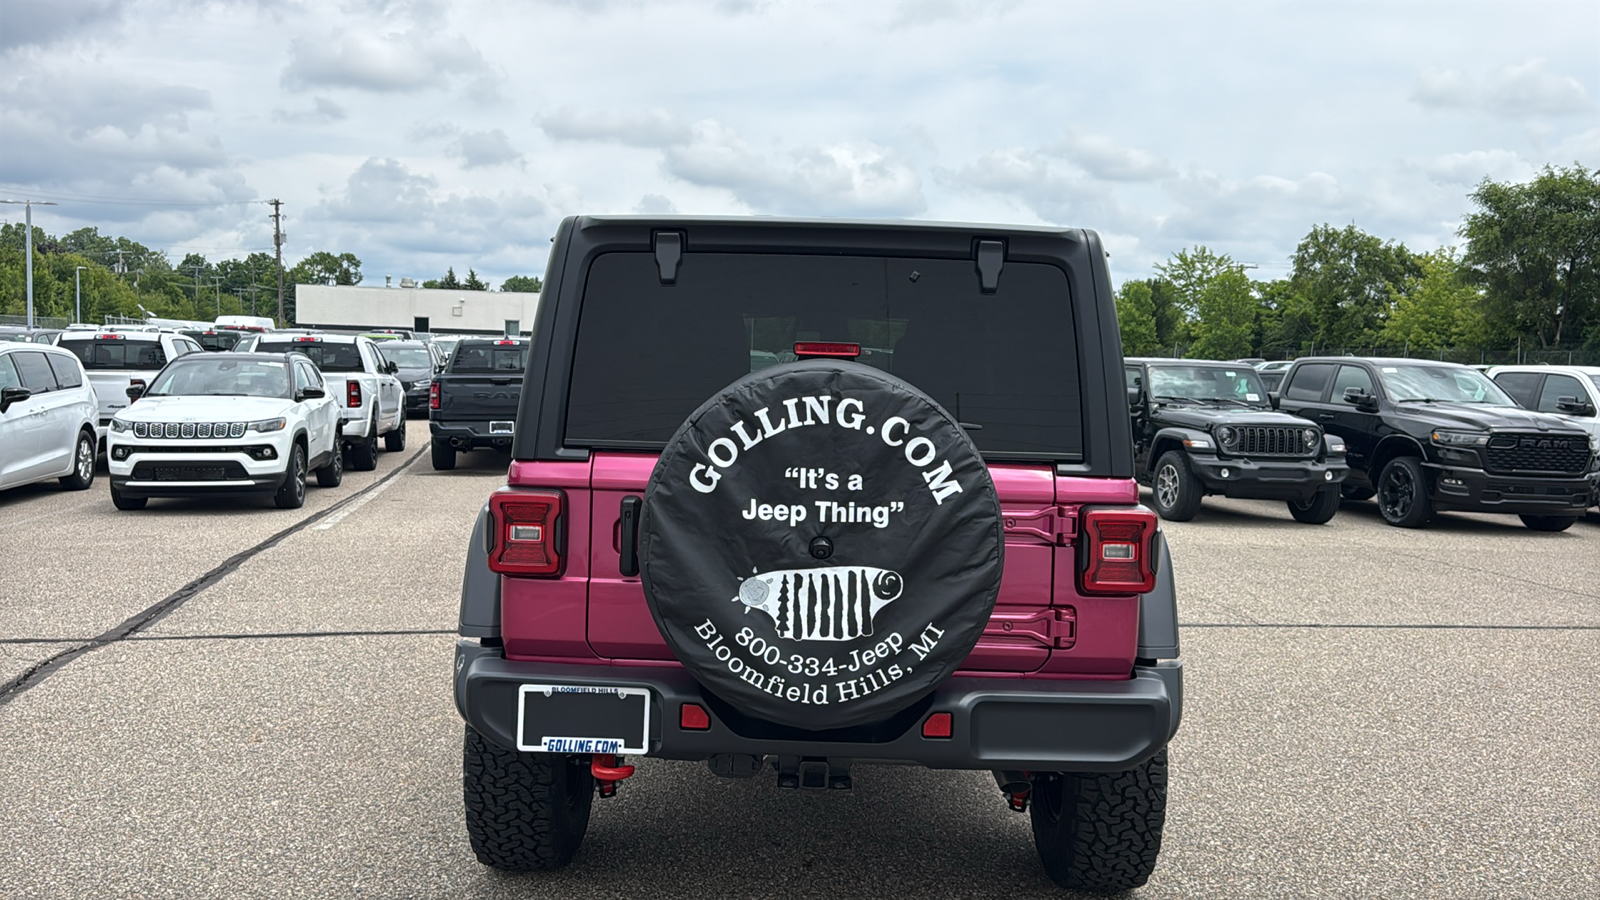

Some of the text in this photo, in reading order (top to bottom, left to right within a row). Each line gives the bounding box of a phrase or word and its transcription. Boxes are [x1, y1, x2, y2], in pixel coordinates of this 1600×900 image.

[689, 395, 963, 505] GOLLING.COM
[1520, 439, 1568, 448] RAM
[848, 473, 863, 491] a
[742, 499, 904, 529] Jeep Thing”
[694, 618, 945, 704] Bloomfield Hills, MI
[735, 626, 903, 676] 800-334-Jeep
[551, 686, 596, 694] BLOOMFIELD
[547, 739, 618, 753] GOLLING.COM
